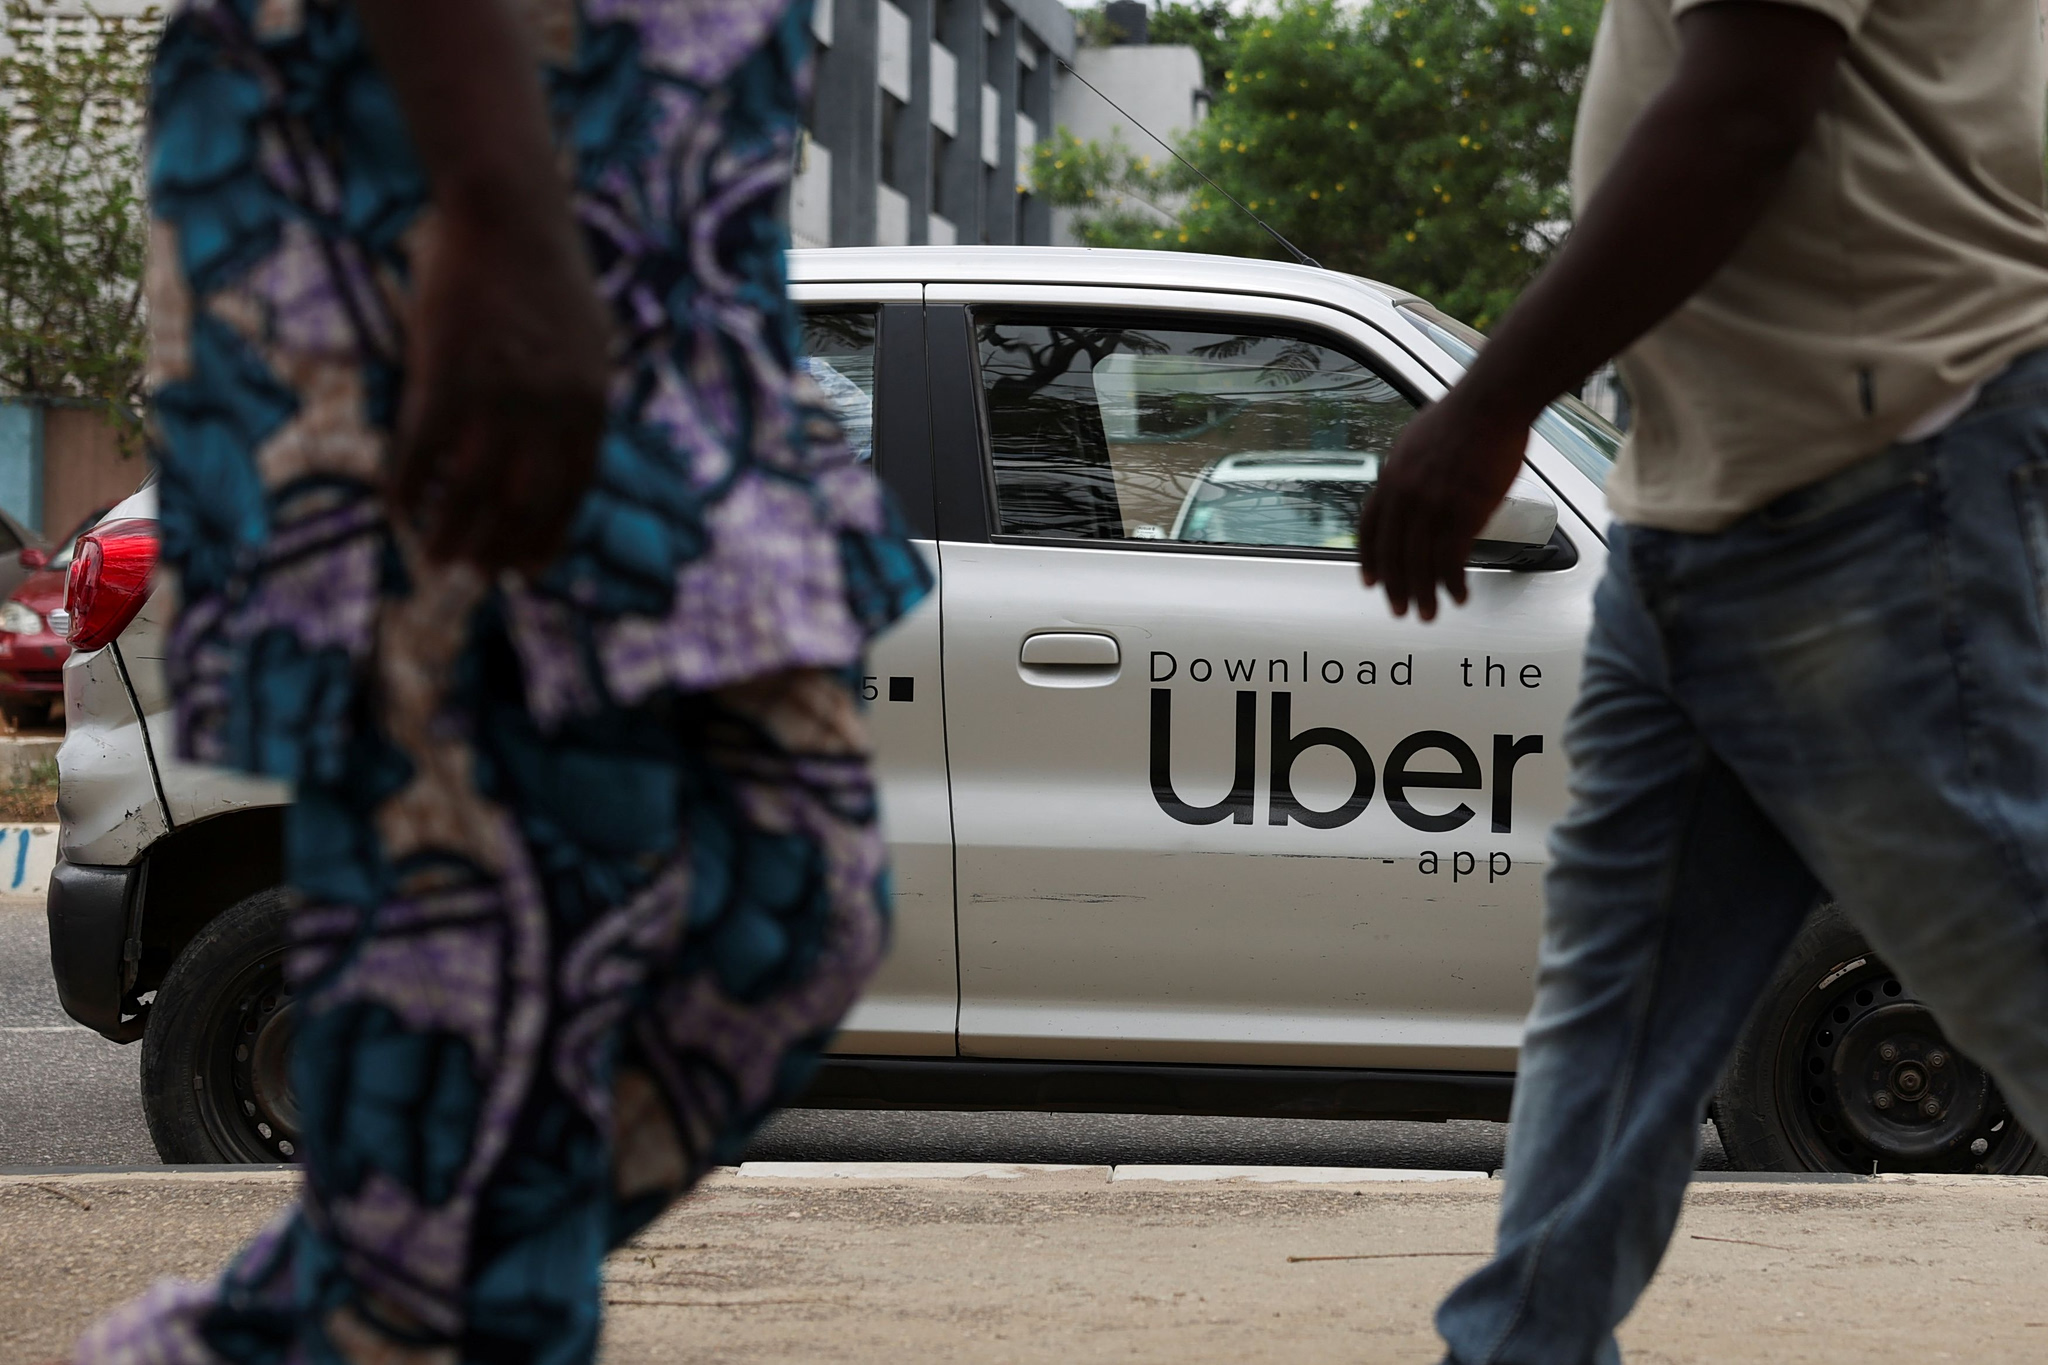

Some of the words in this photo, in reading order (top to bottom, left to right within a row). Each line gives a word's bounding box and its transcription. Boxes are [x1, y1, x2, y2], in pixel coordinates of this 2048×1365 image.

[861, 675, 879, 701] 5
[1149, 650, 1413, 686] Download
[1460, 655, 1542, 689] the
[1149, 687, 1544, 834] Uber
